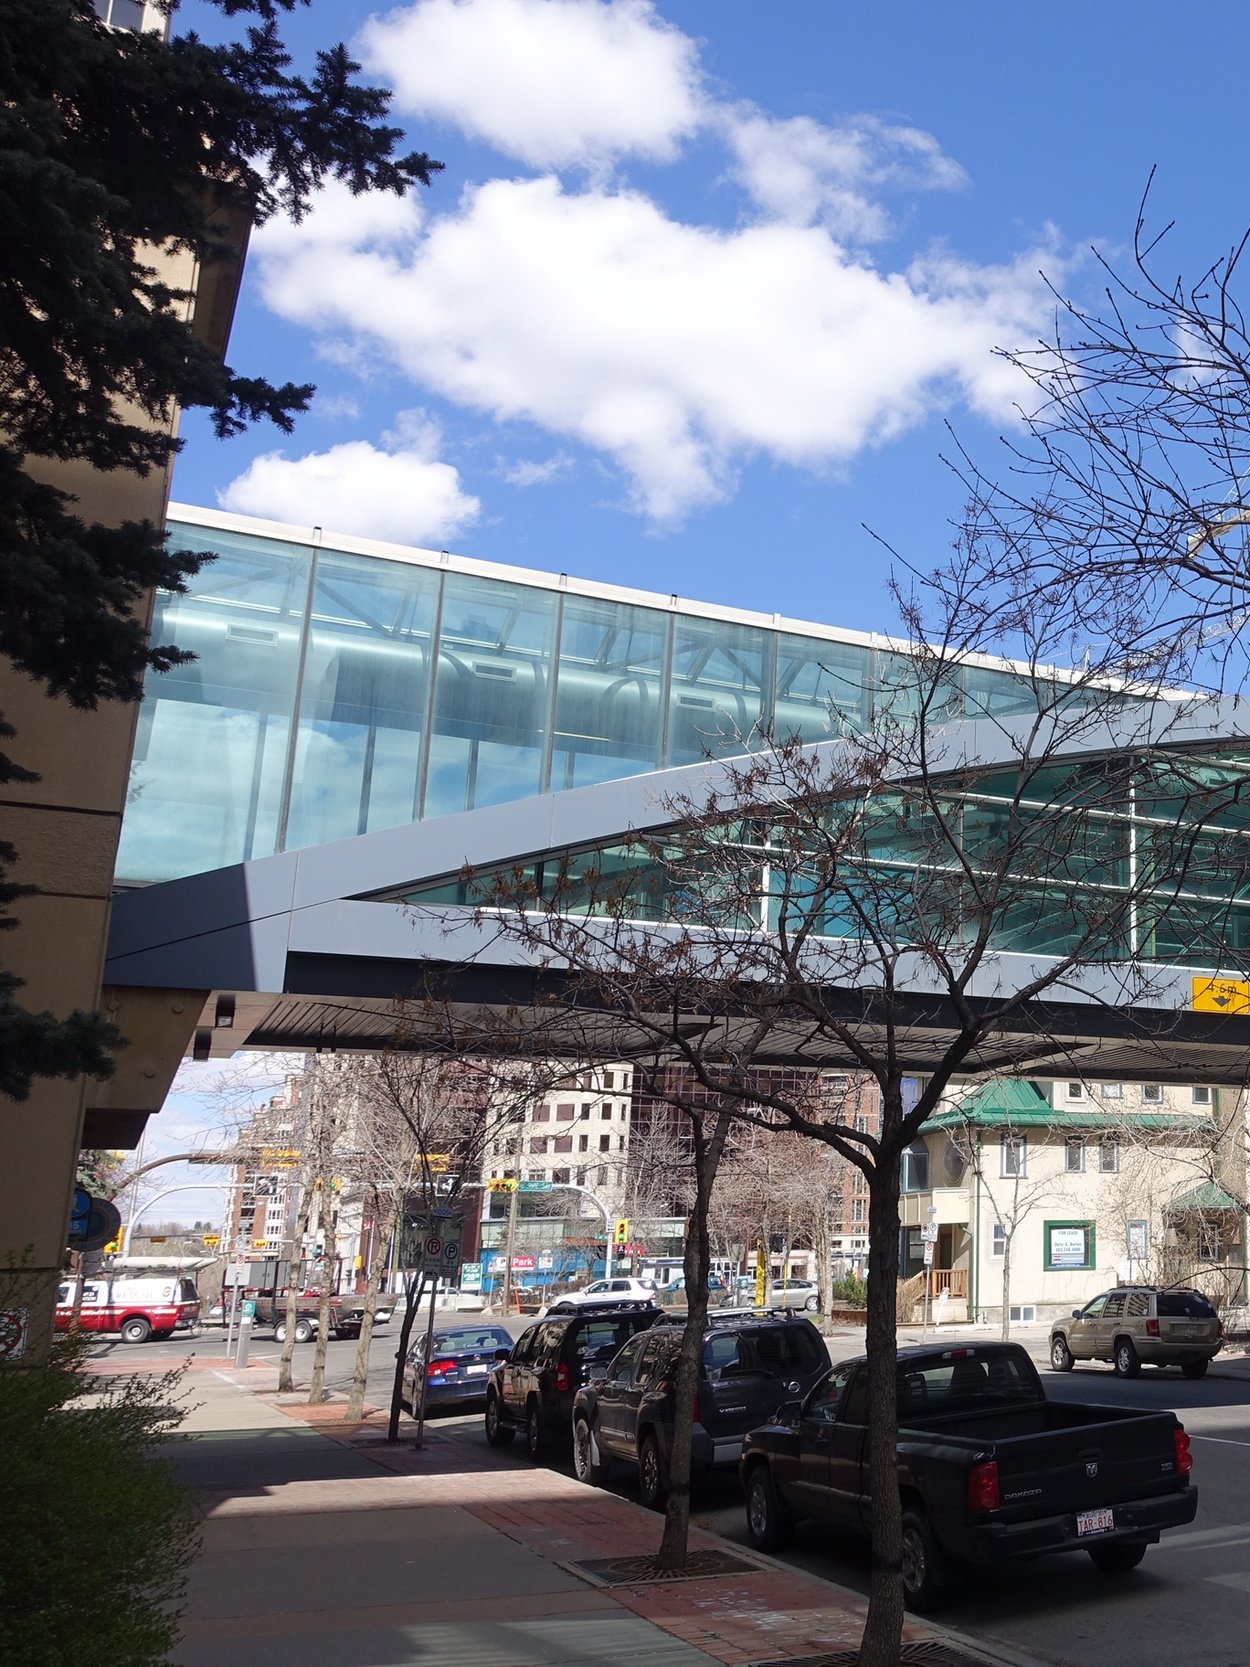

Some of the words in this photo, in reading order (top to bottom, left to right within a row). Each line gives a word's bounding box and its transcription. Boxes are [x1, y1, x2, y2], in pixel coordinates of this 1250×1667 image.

[513, 1257, 533, 1266] Park
[1004, 1488, 1043, 1501] DAKOTA
[1078, 1514, 1114, 1533] TAR-816
